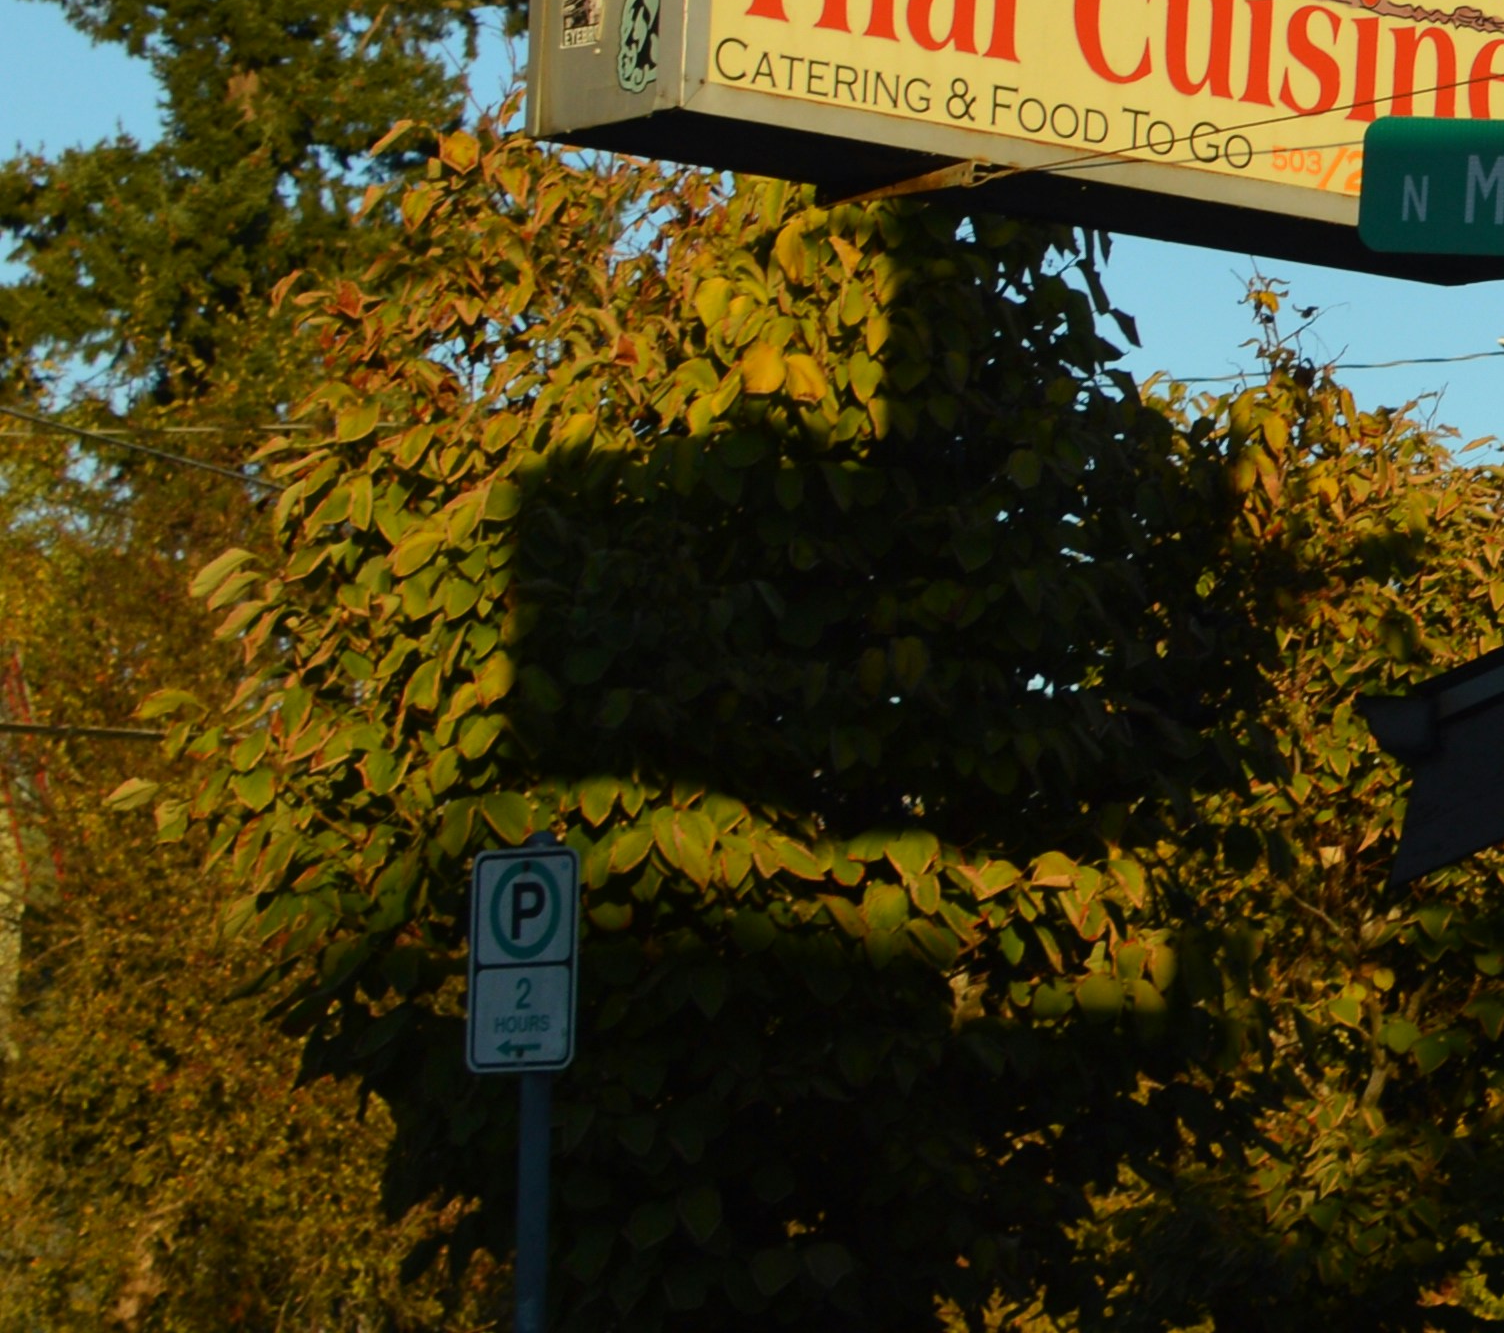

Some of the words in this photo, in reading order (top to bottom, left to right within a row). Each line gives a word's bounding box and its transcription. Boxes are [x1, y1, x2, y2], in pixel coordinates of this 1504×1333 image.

[715, 37, 933, 115] CATERING
[946, 77, 977, 123] &
[990, 83, 1109, 145] FOOD
[1401, 175, 1429, 222] N
[510, 881, 546, 941] P
[515, 977, 532, 1011] 2
[493, 1014, 551, 1034] HOURS
